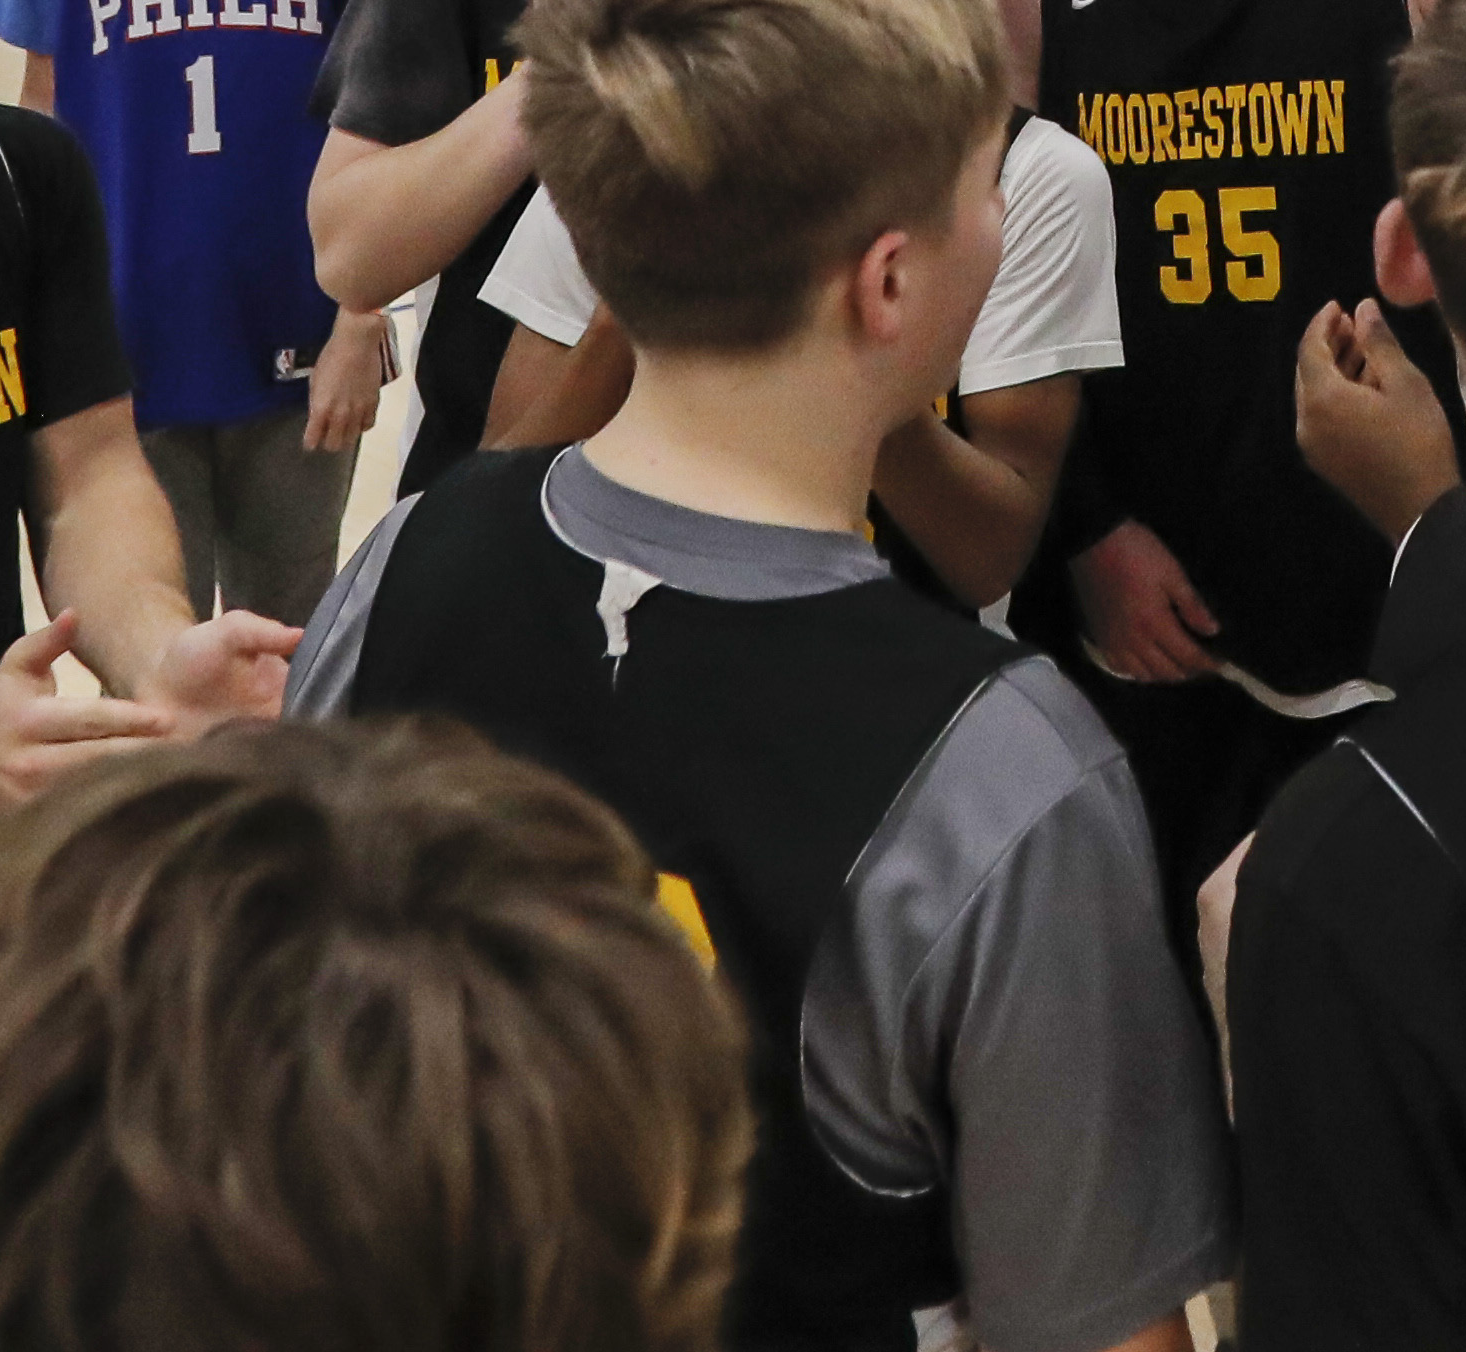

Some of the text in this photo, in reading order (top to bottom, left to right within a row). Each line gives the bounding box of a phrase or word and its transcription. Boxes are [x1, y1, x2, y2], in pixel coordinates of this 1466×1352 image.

[185, 54, 221, 155] 1
[1077, 79, 1345, 165] MOORESTOWN
[1154, 186, 1281, 304] 35
